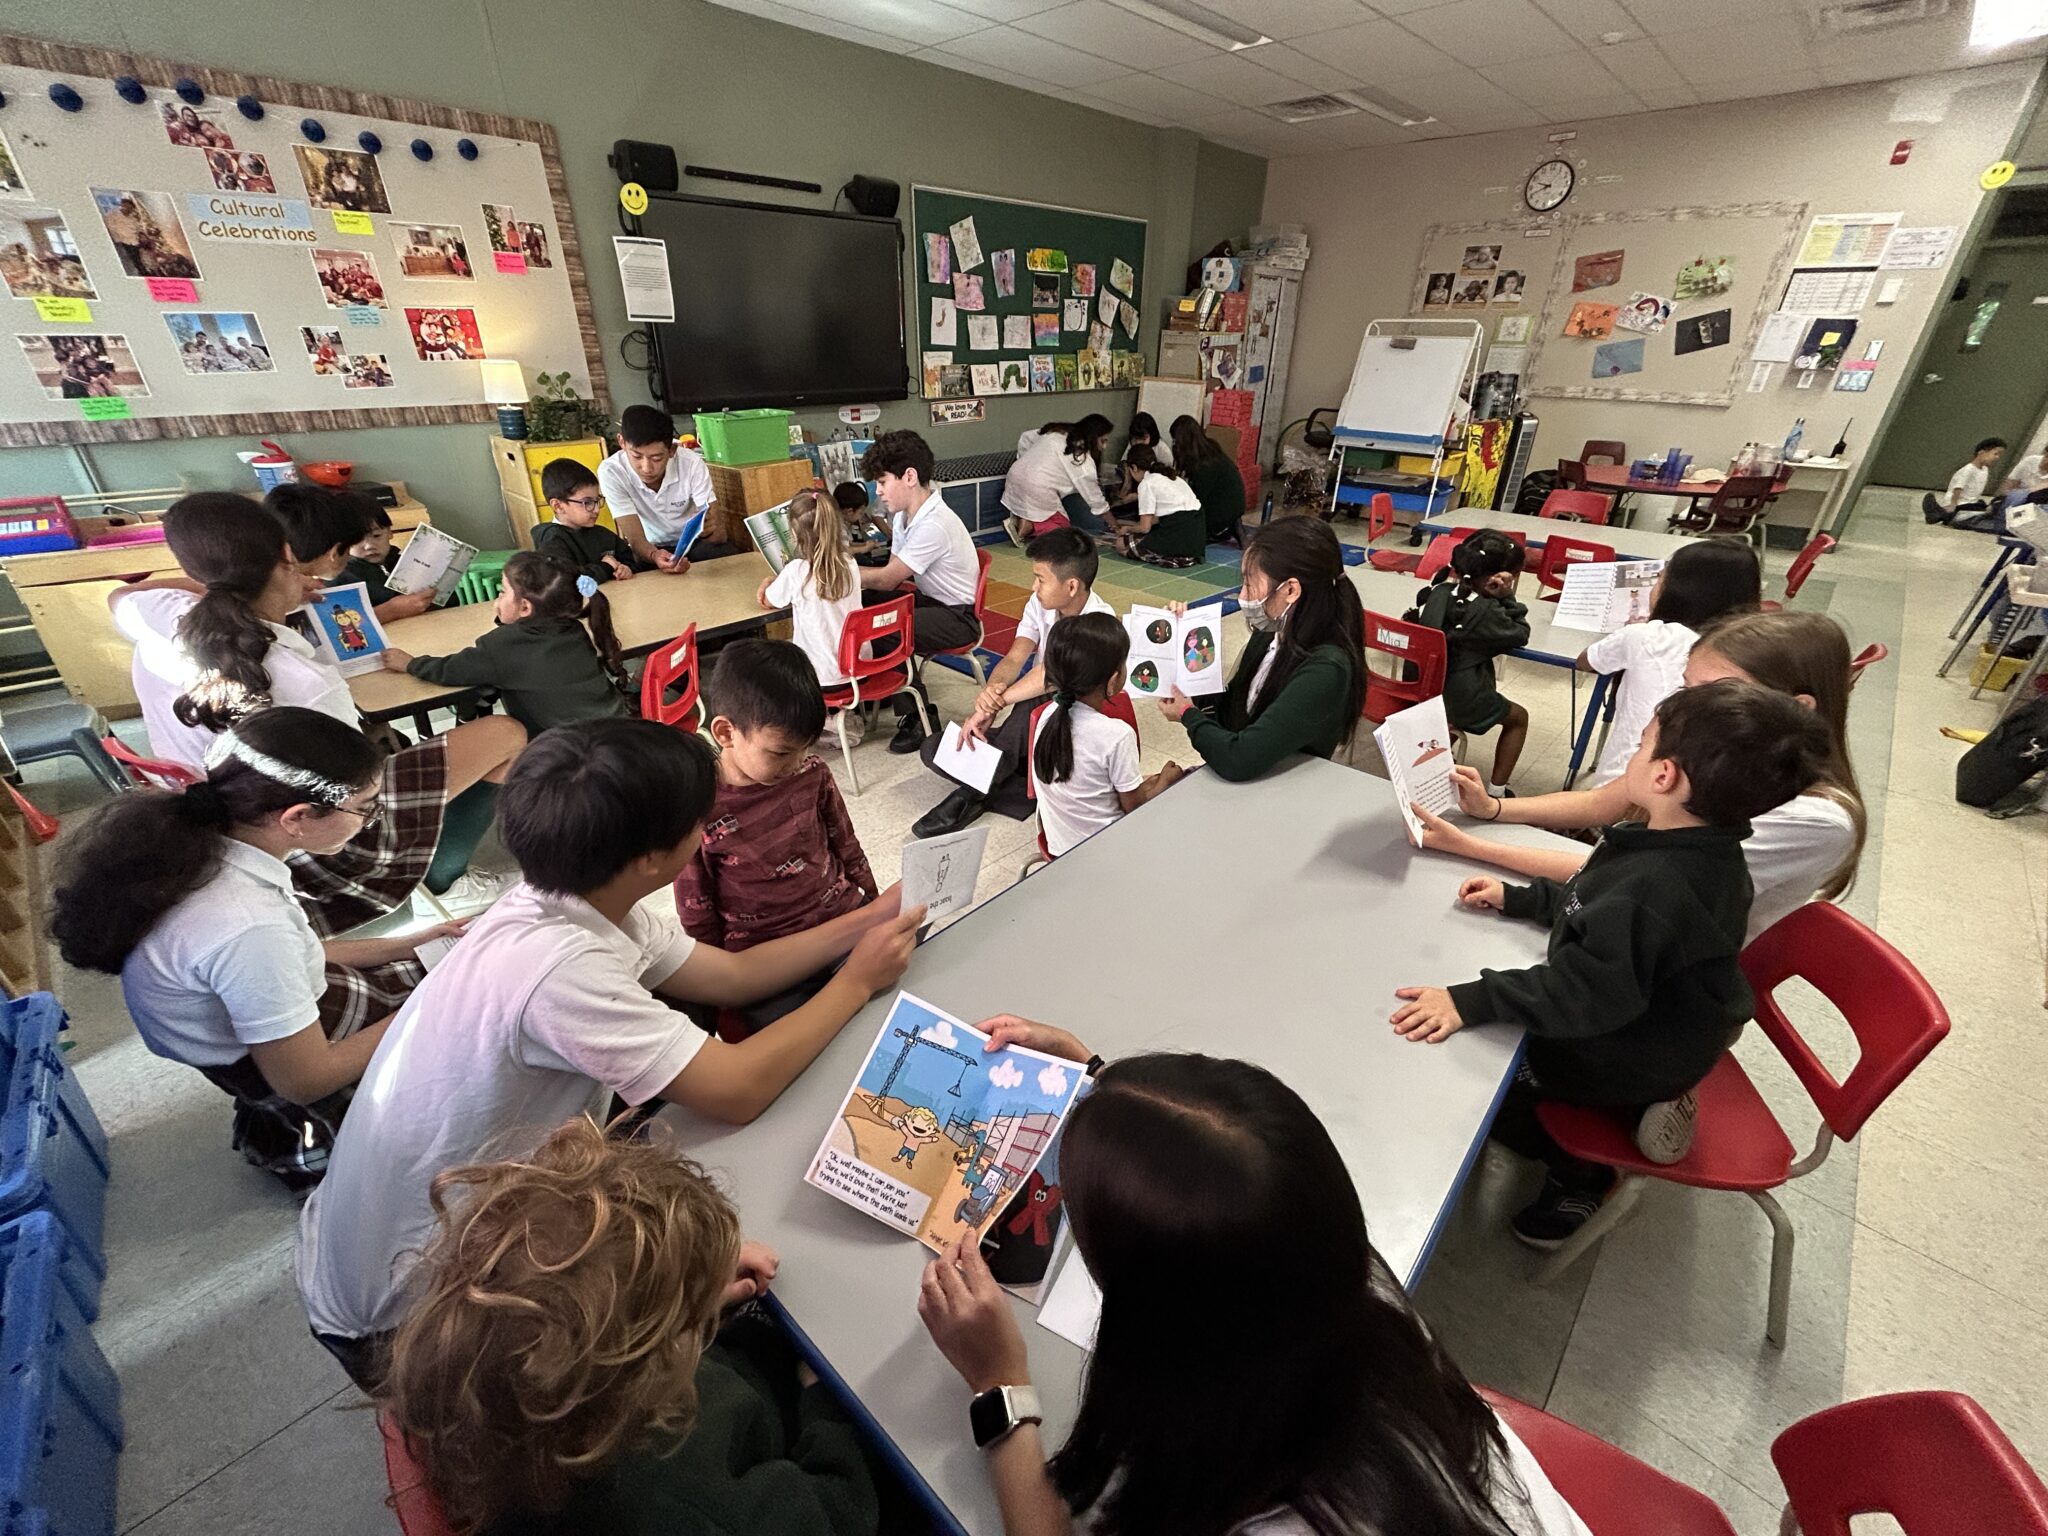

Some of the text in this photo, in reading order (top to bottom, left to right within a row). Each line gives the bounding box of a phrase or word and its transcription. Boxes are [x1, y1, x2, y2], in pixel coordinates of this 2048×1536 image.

[210, 198, 285, 218] Cultural
[198, 221, 318, 242] Celebrations
[950, 411, 967, 419] READ!
[954, 403, 966, 411] love
[840, 1159, 852, 1169] well
[851, 1165, 869, 1178] maybe
[869, 1172, 875, 1181] I
[874, 1177, 885, 1187] can
[884, 1183, 895, 1192] join
[819, 1170, 835, 1185] trying
[835, 1179, 842, 1188] to
[841, 1184, 851, 1193] see
[851, 1190, 869, 1202] where
[880, 1204, 894, 1215] path
[893, 1210, 908, 1223] leads
[853, 1176, 865, 1188] love
[880, 1190, 896, 1204] We're
[895, 1200, 908, 1210] just
